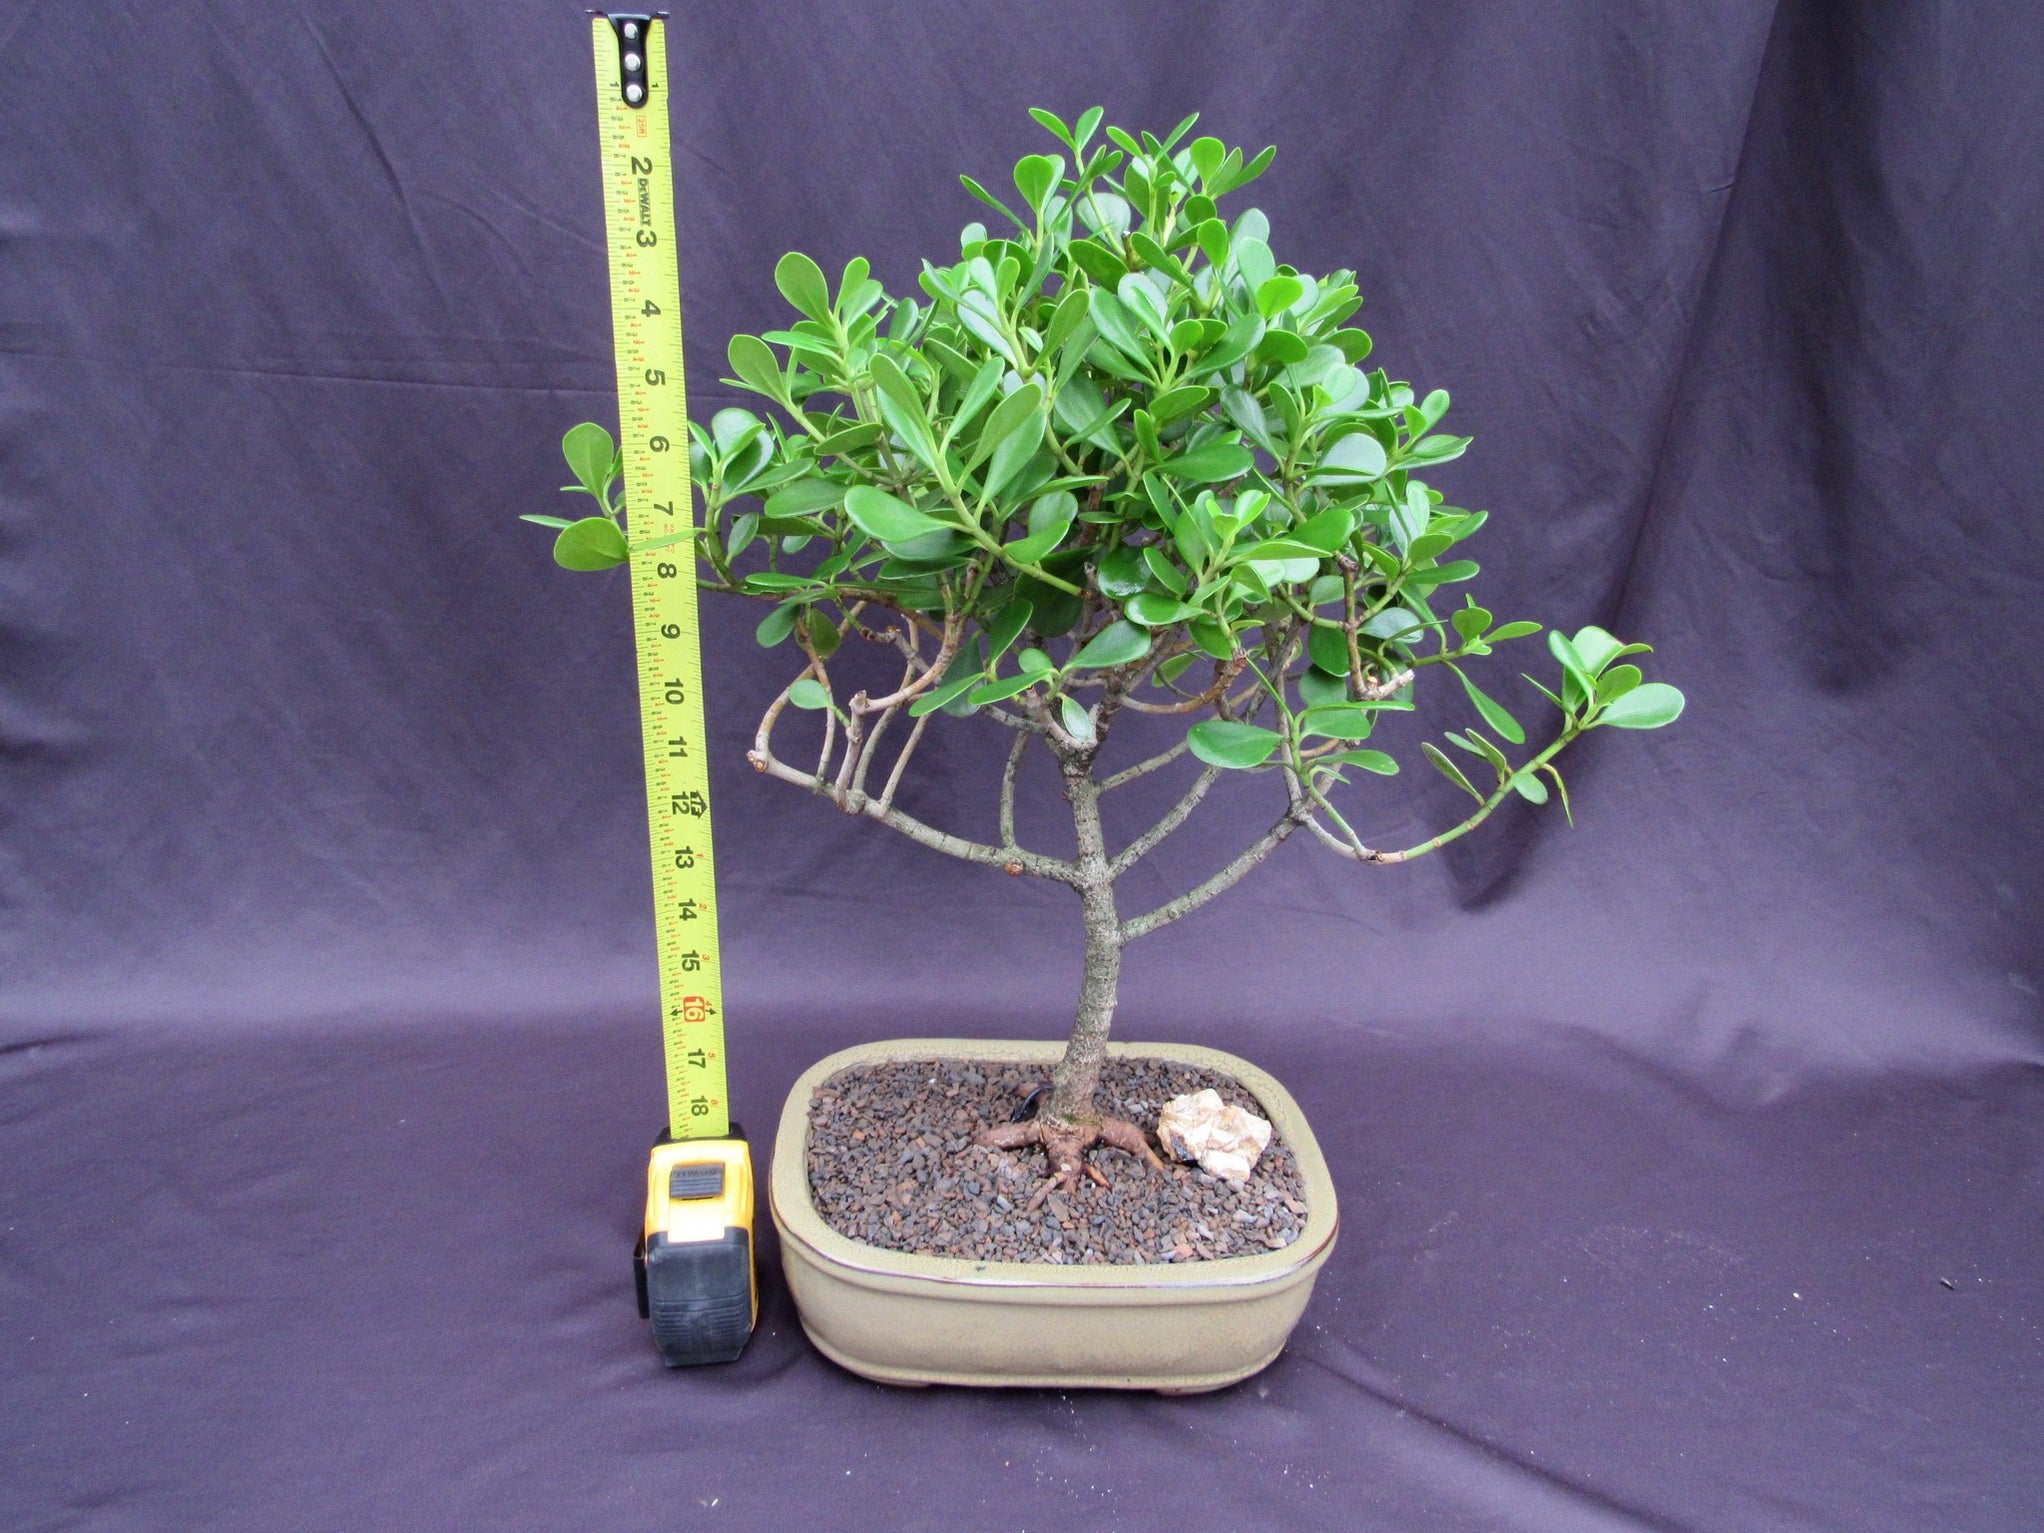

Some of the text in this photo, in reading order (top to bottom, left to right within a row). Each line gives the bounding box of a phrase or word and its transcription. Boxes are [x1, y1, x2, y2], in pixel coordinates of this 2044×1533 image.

[631, 156, 653, 175] 2
[636, 230, 657, 248] 3
[641, 300, 661, 317] 4
[645, 368, 666, 386] 5
[649, 435, 670, 453] 6
[653, 501, 674, 516] 7
[657, 562, 677, 579] 8
[661, 623, 681, 639] 9
[664, 678, 685, 705] 10
[668, 736, 688, 757] 11
[672, 791, 690, 815] 12
[675, 846, 695, 869] 13
[678, 898, 698, 921] 14
[681, 950, 700, 971] 15
[684, 997, 705, 1021] 16
[688, 1048, 706, 1068] 17
[690, 1095, 709, 1116] 18
